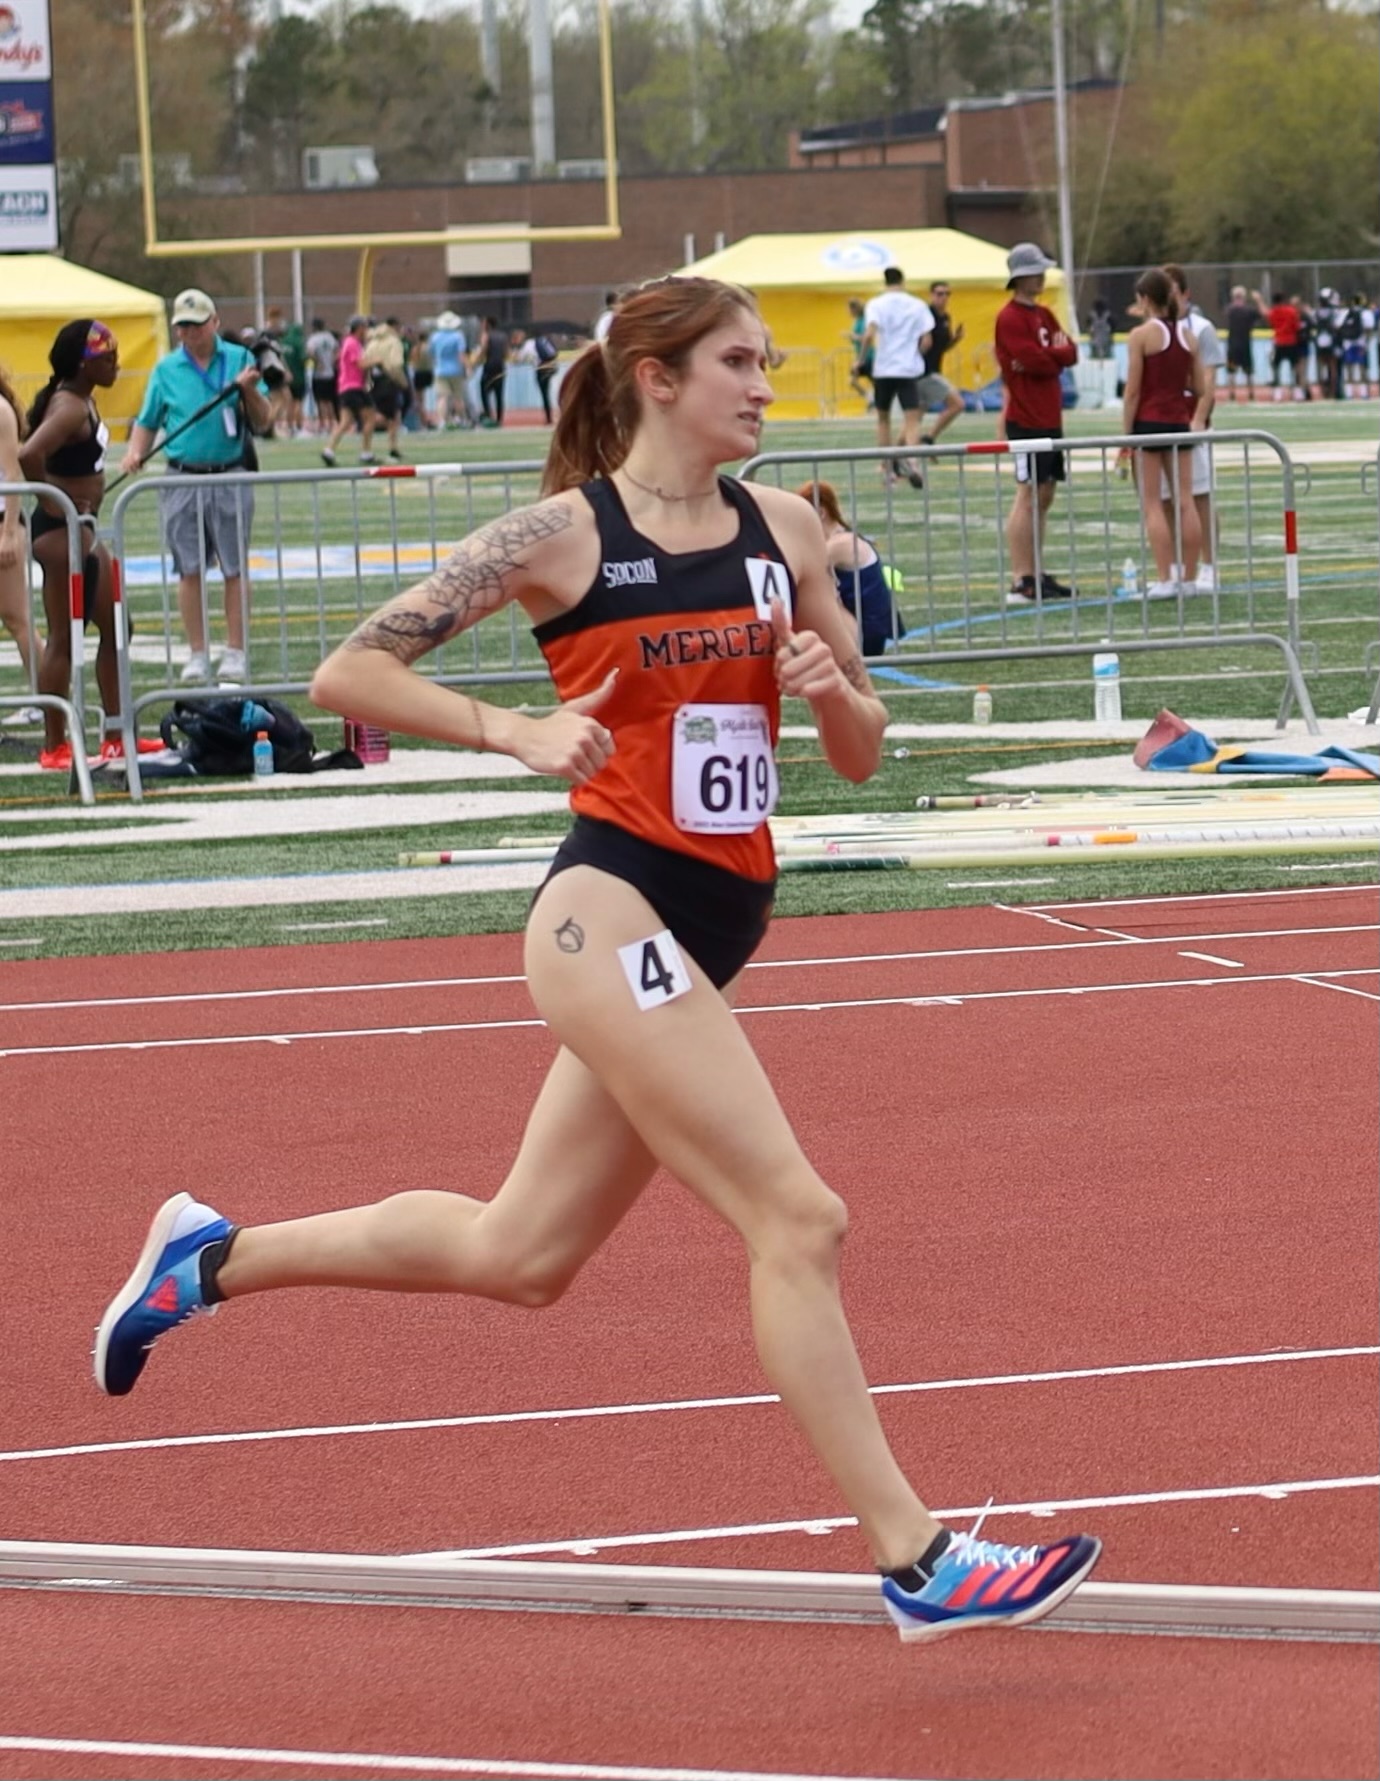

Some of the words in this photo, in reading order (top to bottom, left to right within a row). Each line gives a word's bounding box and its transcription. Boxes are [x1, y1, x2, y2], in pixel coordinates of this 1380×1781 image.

[603, 557, 658, 588] SOCON
[638, 622, 774, 669] MERCE
[700, 754, 768, 813] 619
[641, 940, 674, 996] 4
